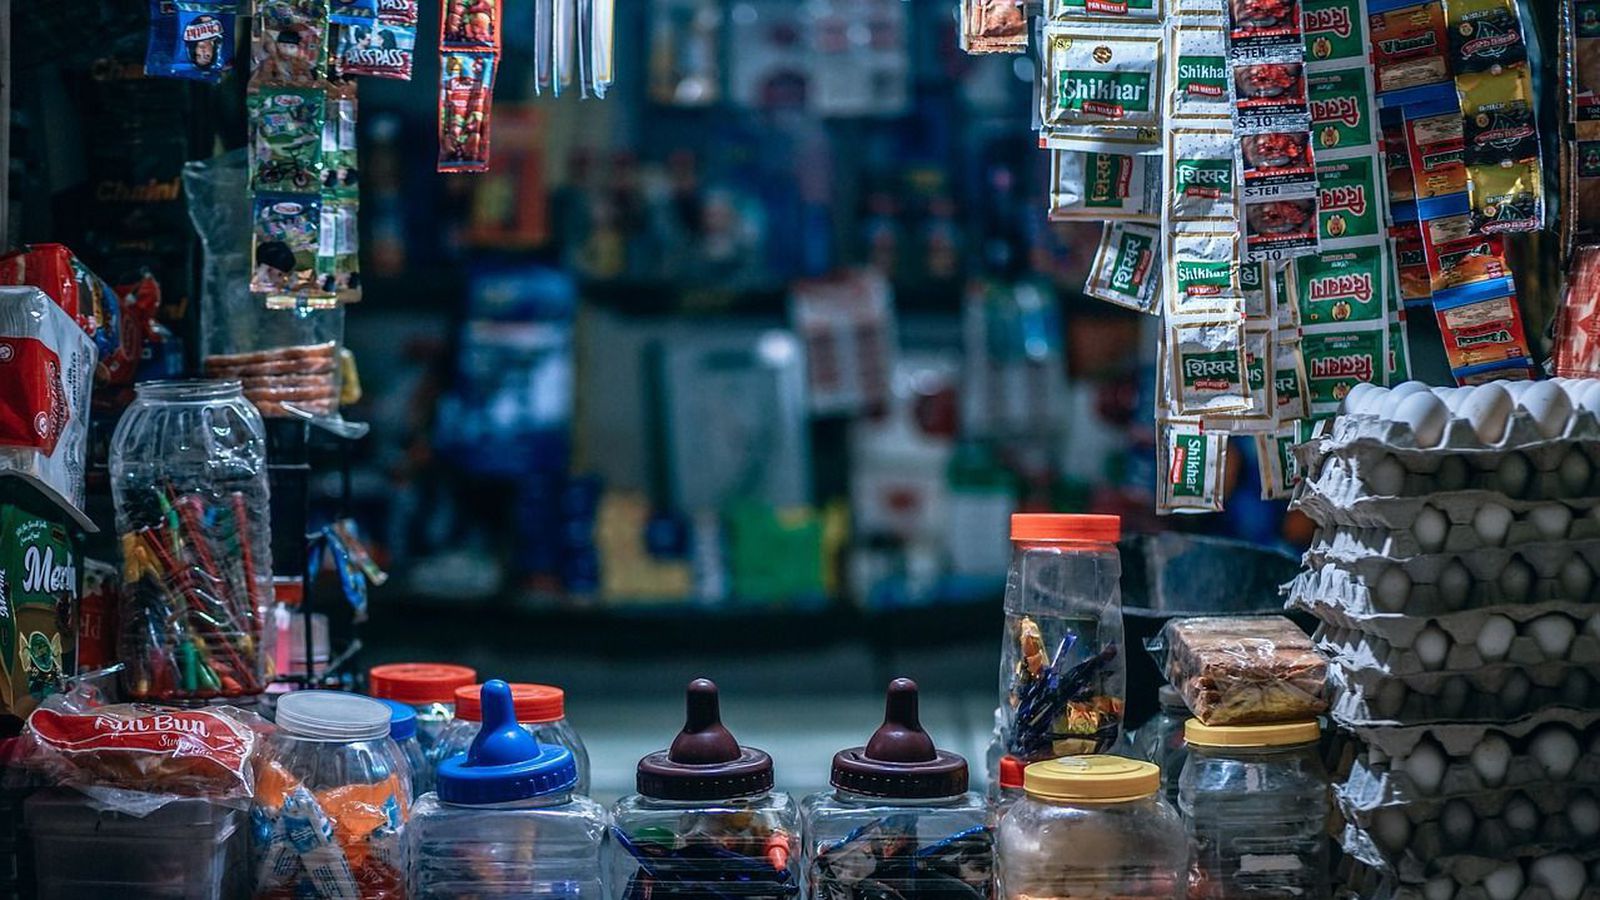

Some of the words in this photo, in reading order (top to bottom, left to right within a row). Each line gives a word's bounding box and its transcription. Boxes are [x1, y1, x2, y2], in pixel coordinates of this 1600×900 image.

[1302, 6, 1352, 38] दिलबा
[1062, 78, 1145, 100] Shikhar
[1238, 116, 1272, 129] S-10
[1310, 96, 1360, 127] दिलबा
[1178, 165, 1230, 184] शिखर
[1244, 186, 1280, 197] S-TEN
[1320, 185, 1366, 216] दिलब
[1113, 238, 1142, 290] शिखर
[1248, 250, 1282, 263] S-10
[1178, 267, 1229, 282] Shikhar
[1310, 272, 1374, 304] दिलबाग
[1185, 358, 1237, 378] शिखर
[1310, 354, 1374, 383] दिलबाग
[1186, 438, 1201, 490] Shikhar
[154, 714, 210, 738] Bun
